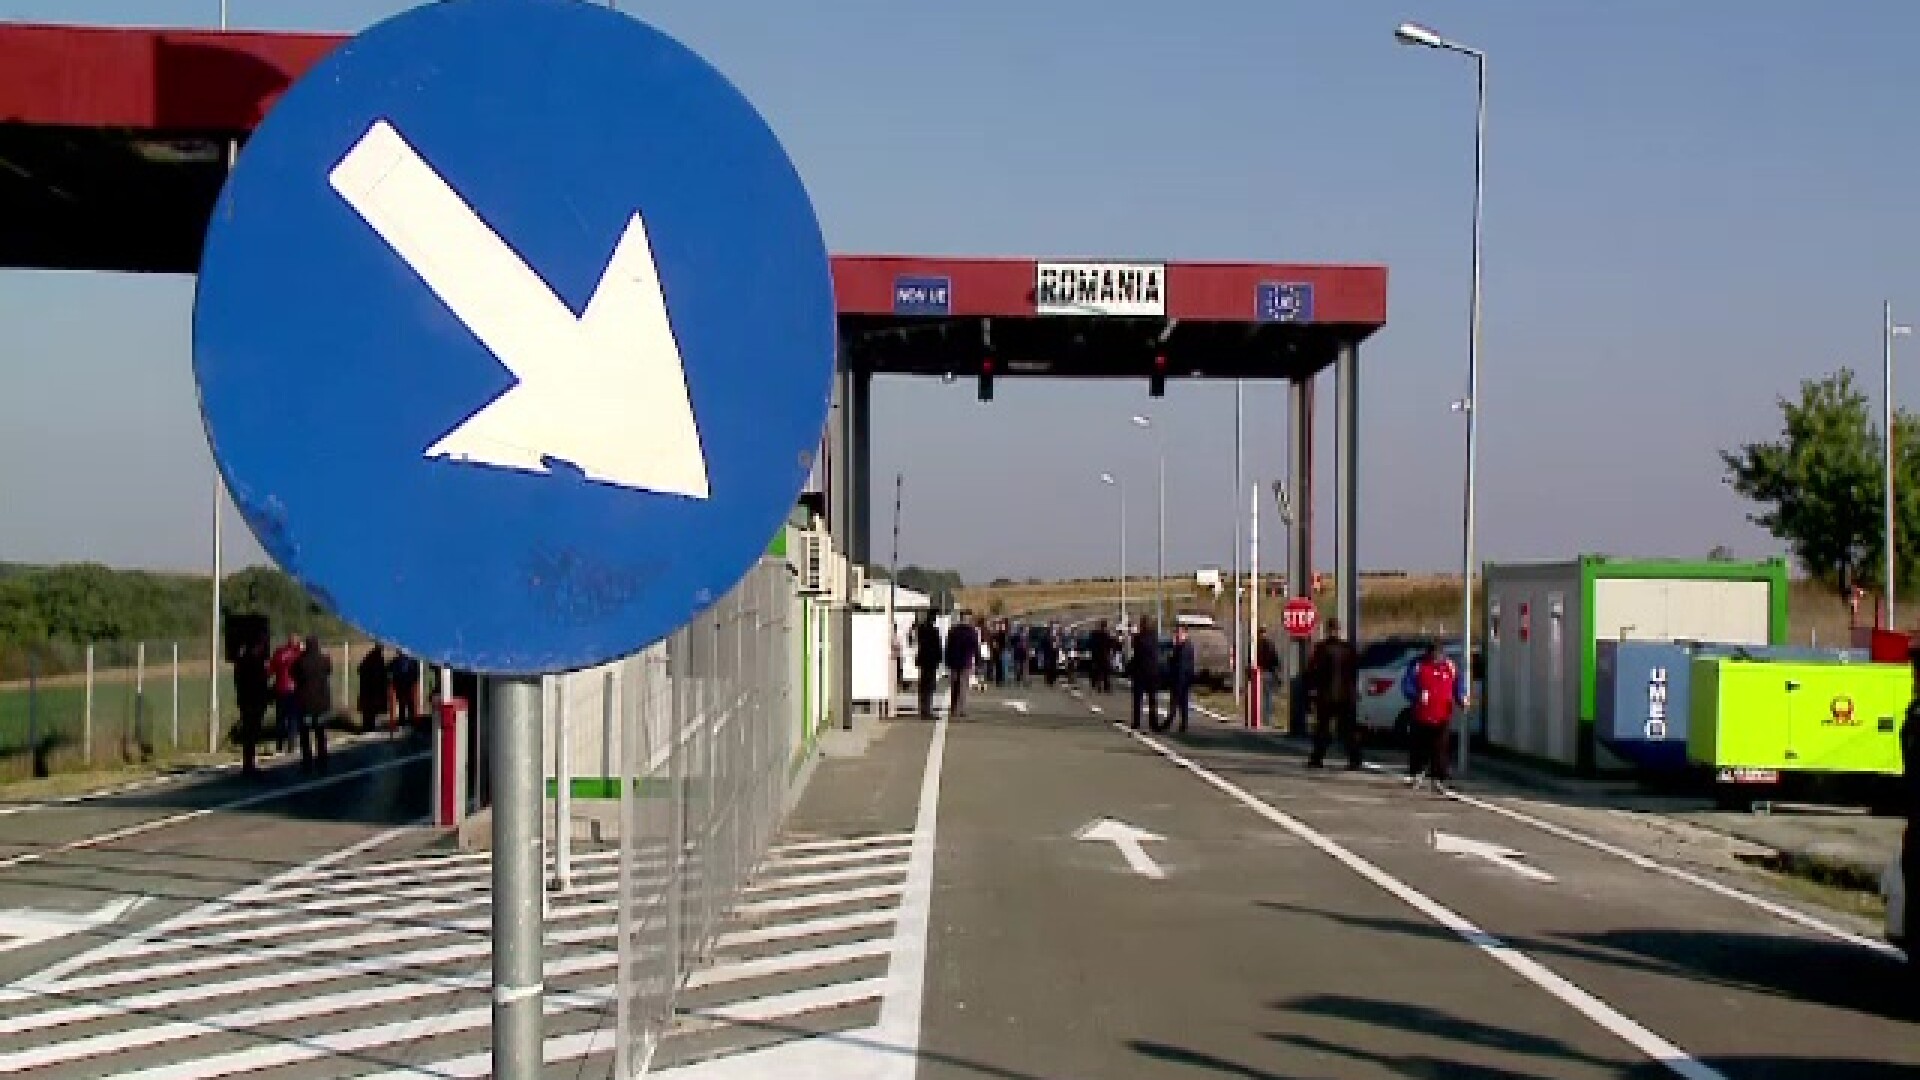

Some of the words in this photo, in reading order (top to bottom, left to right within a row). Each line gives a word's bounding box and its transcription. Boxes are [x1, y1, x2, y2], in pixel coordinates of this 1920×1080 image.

[1041, 269, 1158, 303] ROMANIA
[897, 287, 926, 303] NON
[1283, 610, 1315, 627] STOP
